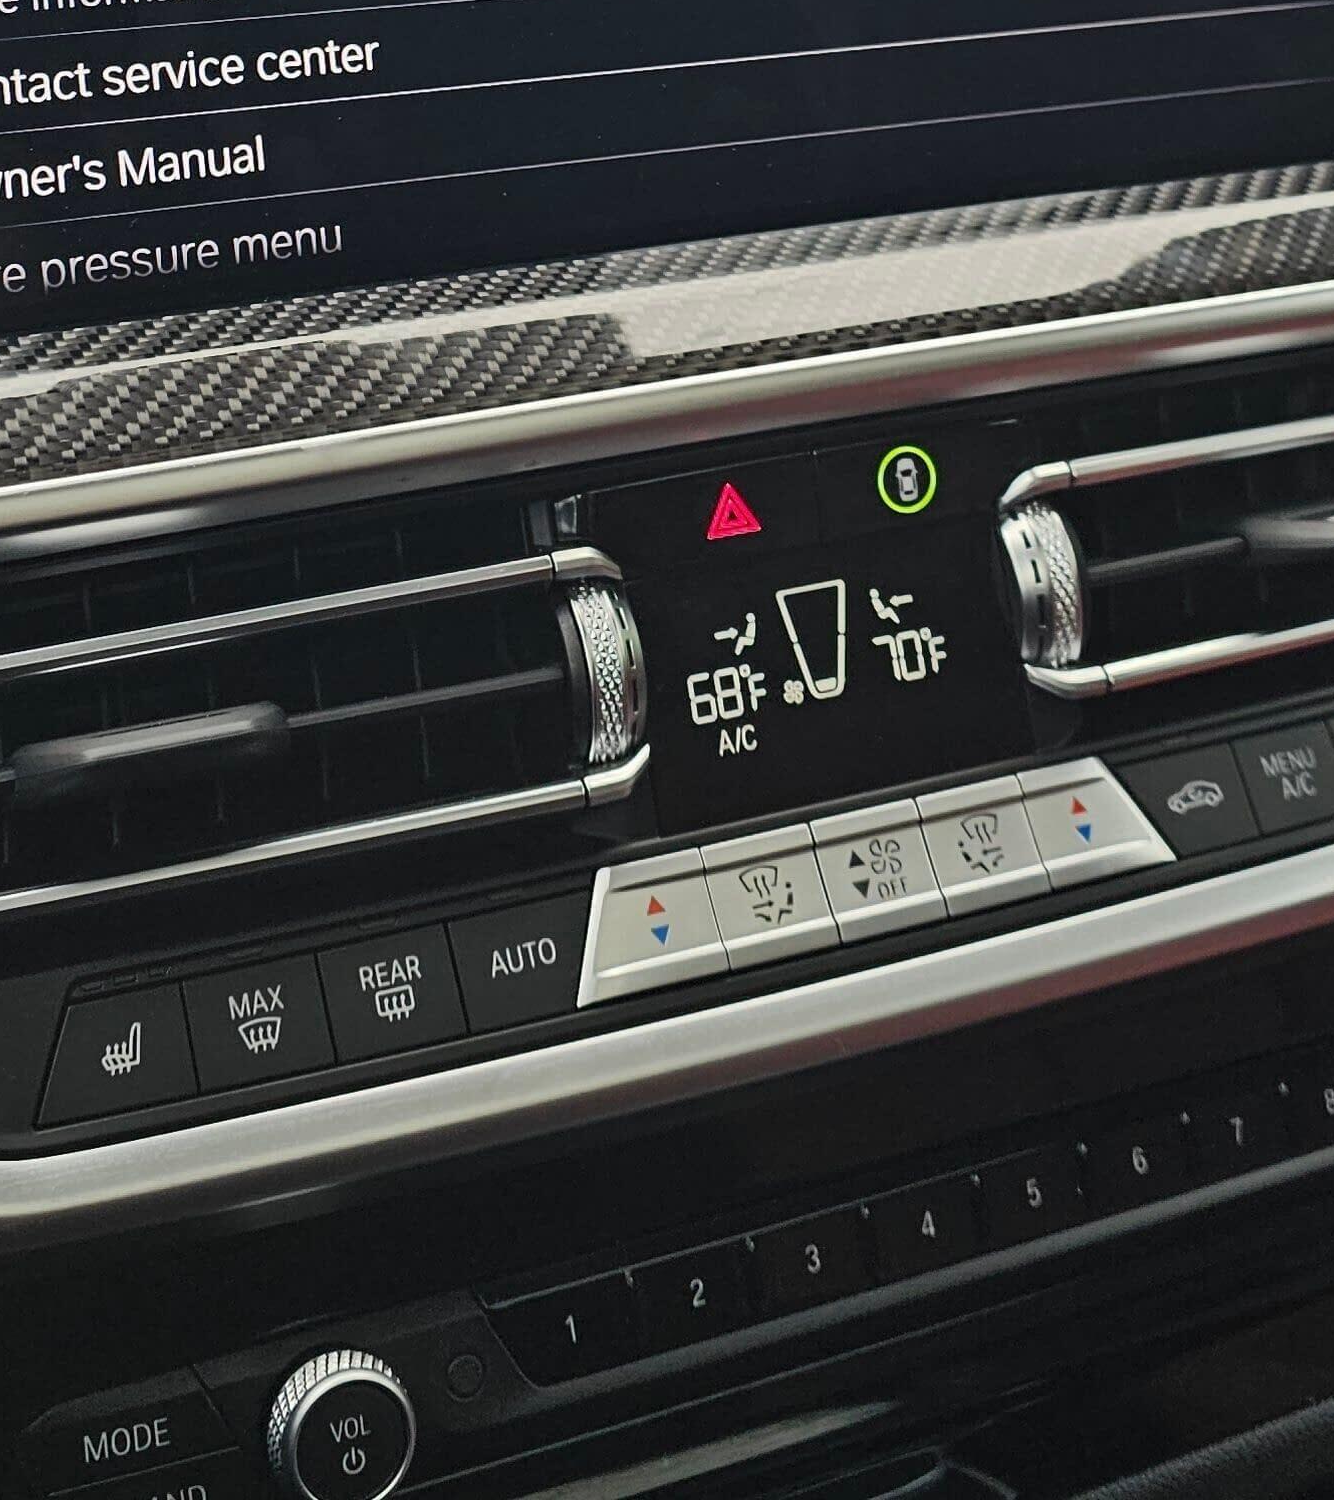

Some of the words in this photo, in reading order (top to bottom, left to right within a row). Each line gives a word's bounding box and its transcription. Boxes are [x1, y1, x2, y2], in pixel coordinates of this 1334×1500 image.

[102, 50, 245, 96] service
[256, 39, 380, 81] center
[117, 134, 265, 187] Manual
[40, 239, 220, 290] pressure
[232, 224, 342, 264] menu
[719, 723, 758, 757] A/C
[1259, 746, 1317, 778] MENU
[1281, 771, 1318, 800] A/C
[876, 874, 908, 900] OFF
[358, 955, 422, 990] REAR
[491, 937, 557, 978] AUTO
[228, 984, 285, 1020] MAX
[1230, 1116, 1244, 1145] 7
[1132, 1146, 1148, 1175] 6
[1026, 1178, 1042, 1207] 5
[921, 1210, 935, 1236] 4
[805, 1244, 821, 1273] 3
[690, 1278, 706, 1308] 2
[565, 1315, 577, 1343] 1
[83, 1417, 170, 1463] MODE
[329, 1414, 367, 1443] VOL
